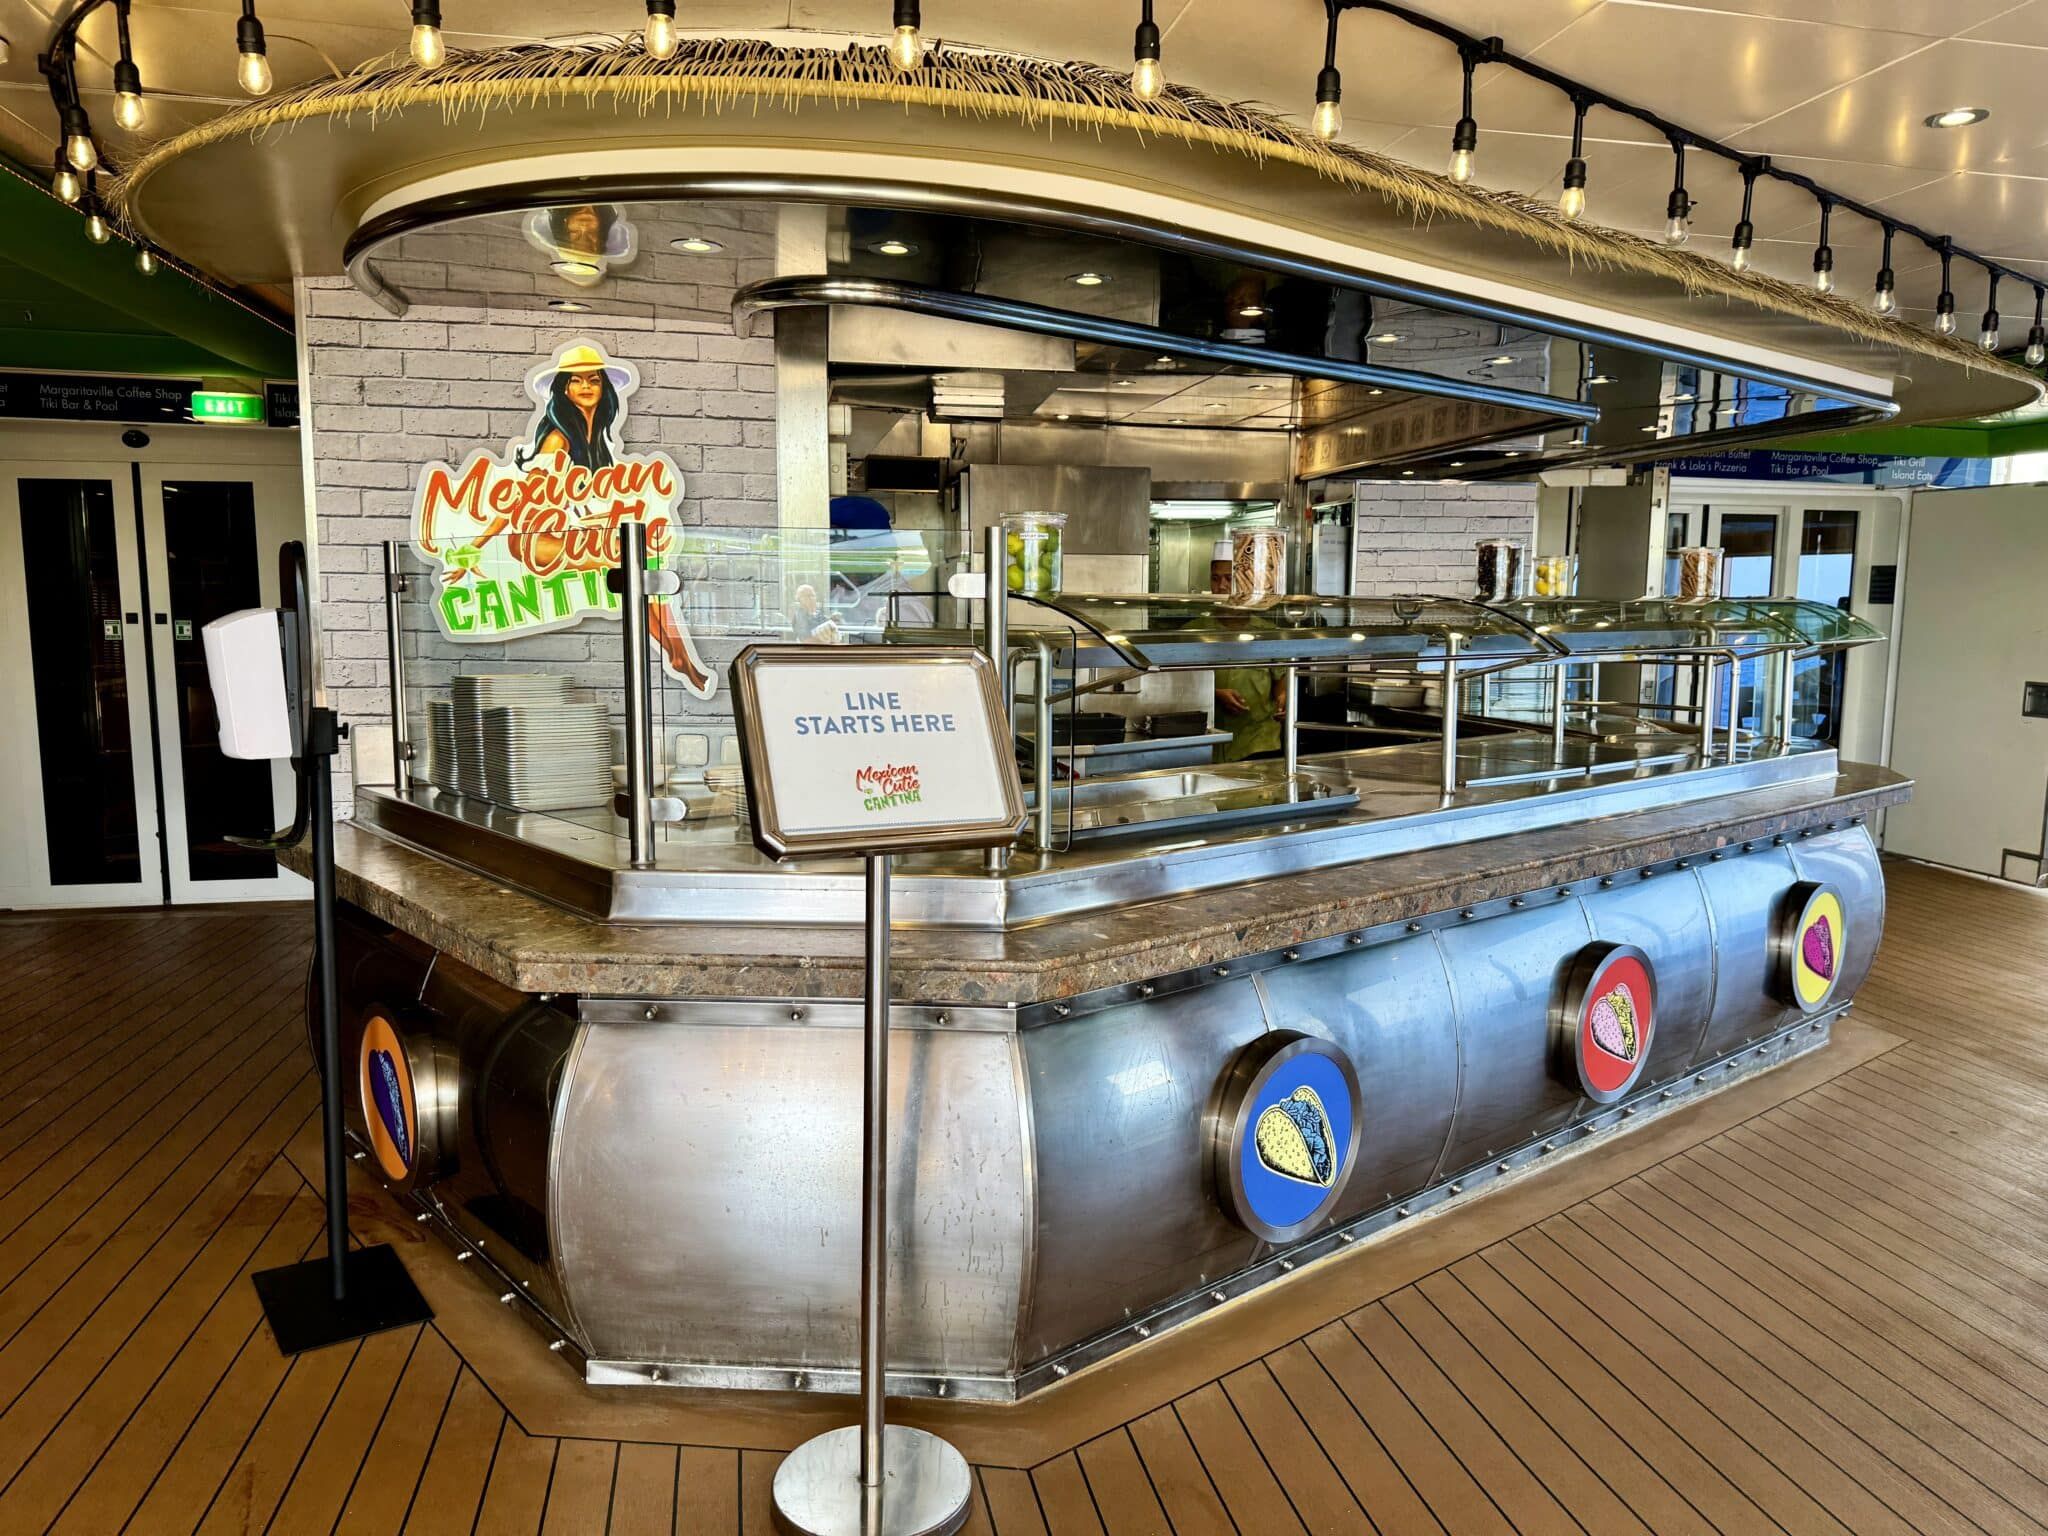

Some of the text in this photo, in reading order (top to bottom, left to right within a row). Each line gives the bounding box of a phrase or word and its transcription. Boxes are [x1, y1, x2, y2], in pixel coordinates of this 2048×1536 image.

[39, 384, 183, 403] Margaritaville Coffee Shop
[40, 398, 119, 411] Tiki Bar & Pool
[205, 399, 244, 414] EXIT
[274, 407, 297, 417] Islan
[1680, 460, 1687, 470] &
[1689, 460, 1712, 471] Lola's
[1714, 461, 1748, 473] Pizzeria
[1771, 451, 1878, 467] Margaritaville Coffee Shop
[1893, 456, 1926, 467] Tiki Grill
[1771, 464, 1829, 476] Tiki Bar & Pool
[1891, 469, 1915, 480] Island
[419, 451, 672, 553] Mexican
[441, 557, 664, 632] CANTI
[845, 692, 901, 711] LINE
[795, 714, 956, 735] STARTS HERE
[856, 763, 919, 792] Mexican
[883, 776, 920, 796] Cutie
[864, 790, 921, 811] CANTINA
